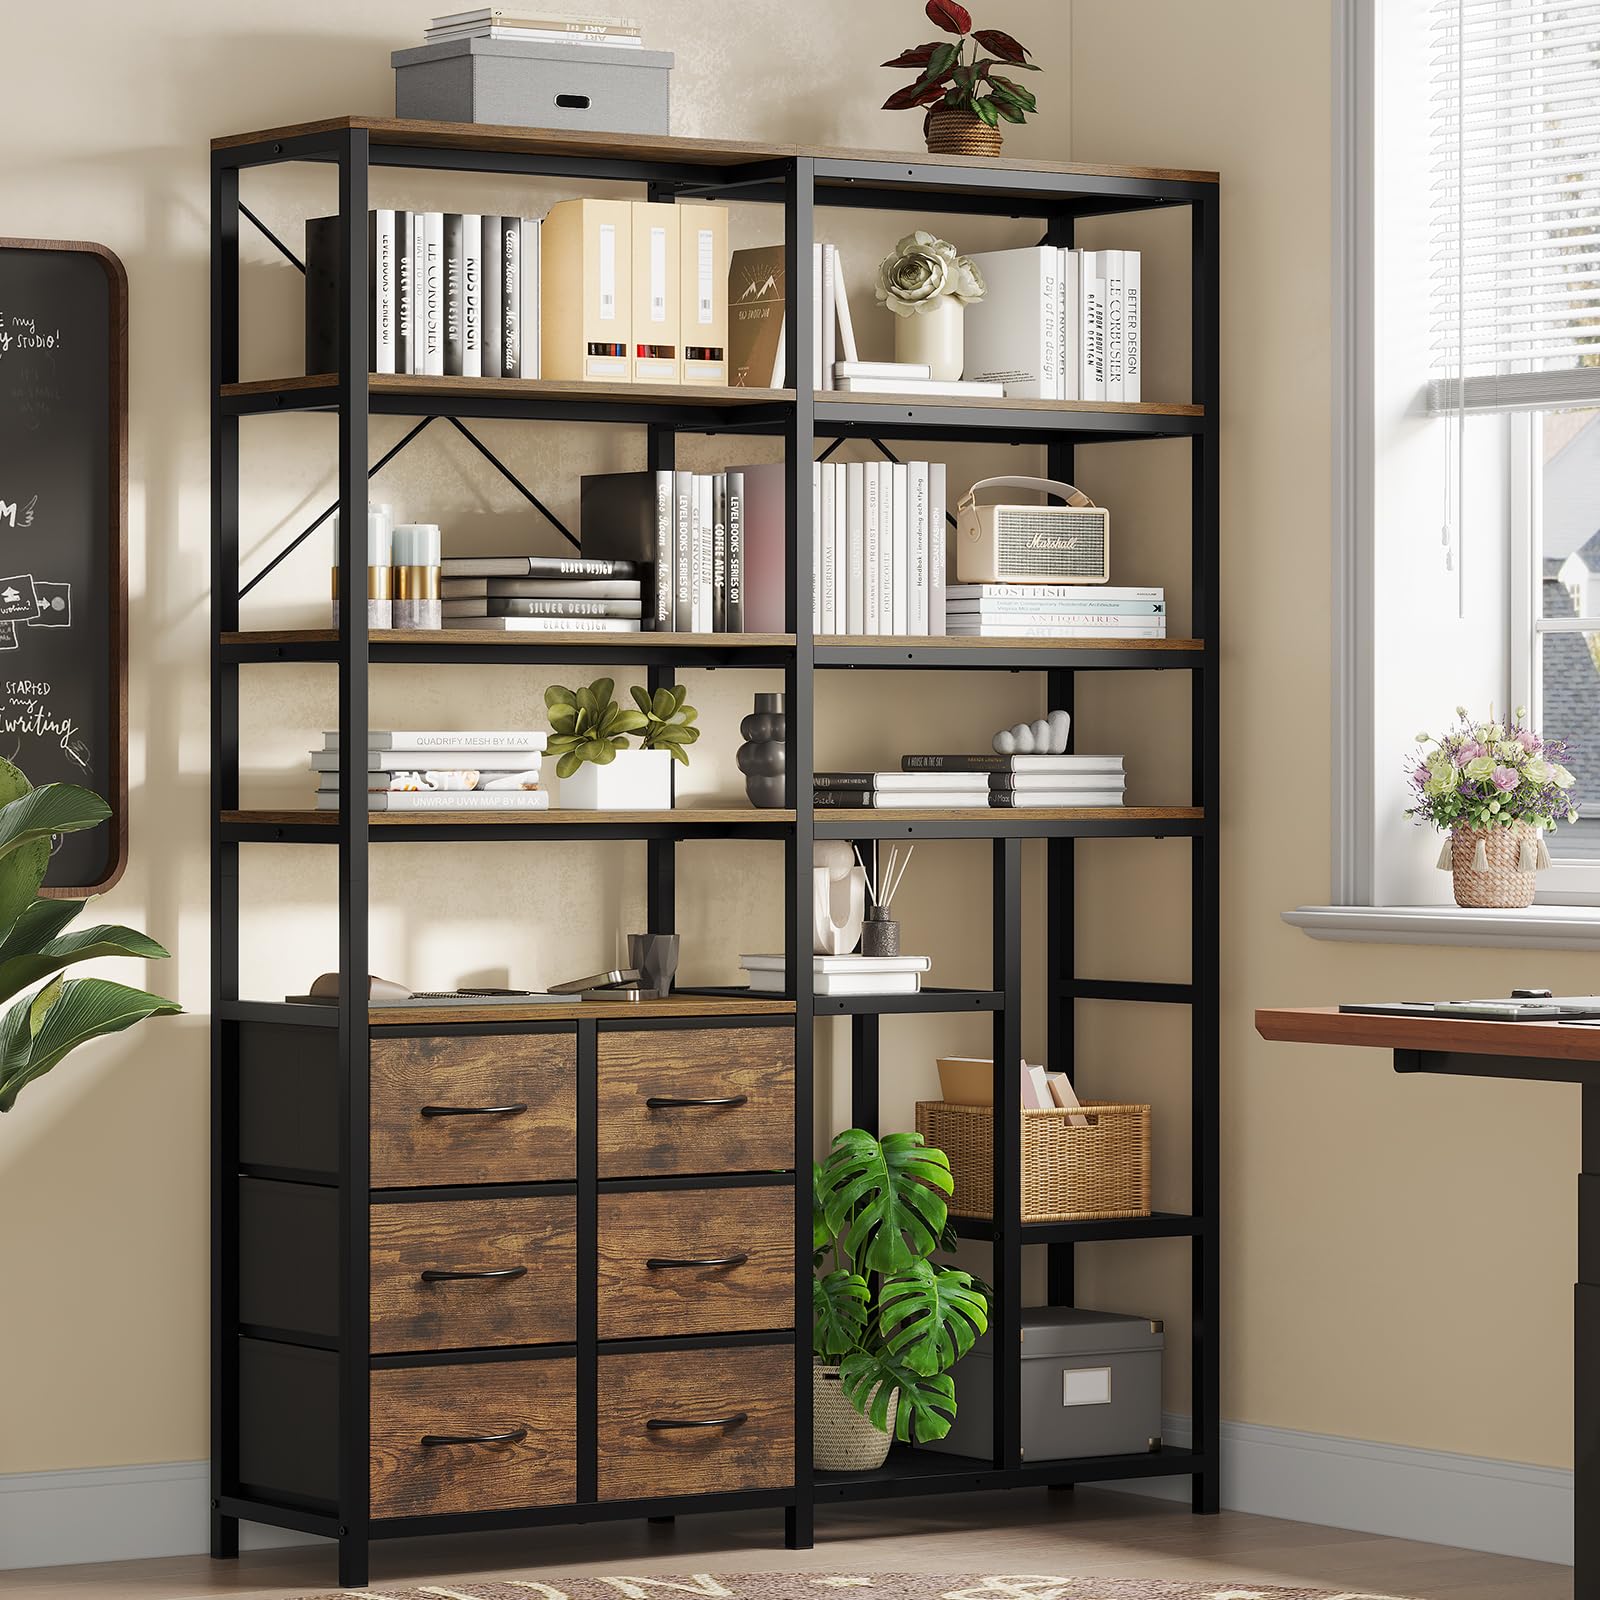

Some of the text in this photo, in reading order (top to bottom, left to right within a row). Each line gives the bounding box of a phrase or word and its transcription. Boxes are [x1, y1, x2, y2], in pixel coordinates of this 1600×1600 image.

[505, 230, 517, 259] Class
[505, 261, 517, 294] Room
[466, 257, 479, 351] KIDS DESIGN
[448, 301, 459, 340] DESIGN
[1043, 276, 1055, 381] Day of the design
[1095, 311, 1103, 329] BOOK
[1110, 279, 1121, 383] LE CORBUSIER
[1127, 288, 1137, 375] BETTER DESIGN
[505, 329, 517, 370] Posada
[1095, 331, 1103, 355] ABOUT
[1095, 356, 1103, 383] POINTS
[679, 495, 688, 520] LEVEL
[730, 496, 739, 522] LEVEL
[679, 521, 688, 551] BOOKS
[730, 523, 739, 552] BOOKS
[1026, 533, 1078, 549] Marshall
[714, 523, 724, 588] COFFEE ATLAS
[679, 557, 688, 586] SERIES
[730, 559, 739, 587] SERIES
[529, 602, 605, 615] SILVER DESIGN
[679, 588, 688, 603] 001
[730, 588, 739, 604] 001
[0, 705, 78, 749] writing
[416, 737, 463, 746] QUADRIFY
[465, 737, 491, 746] MESH
[492, 737, 506, 746] BY
[412, 797, 454, 807] UNWRAP
